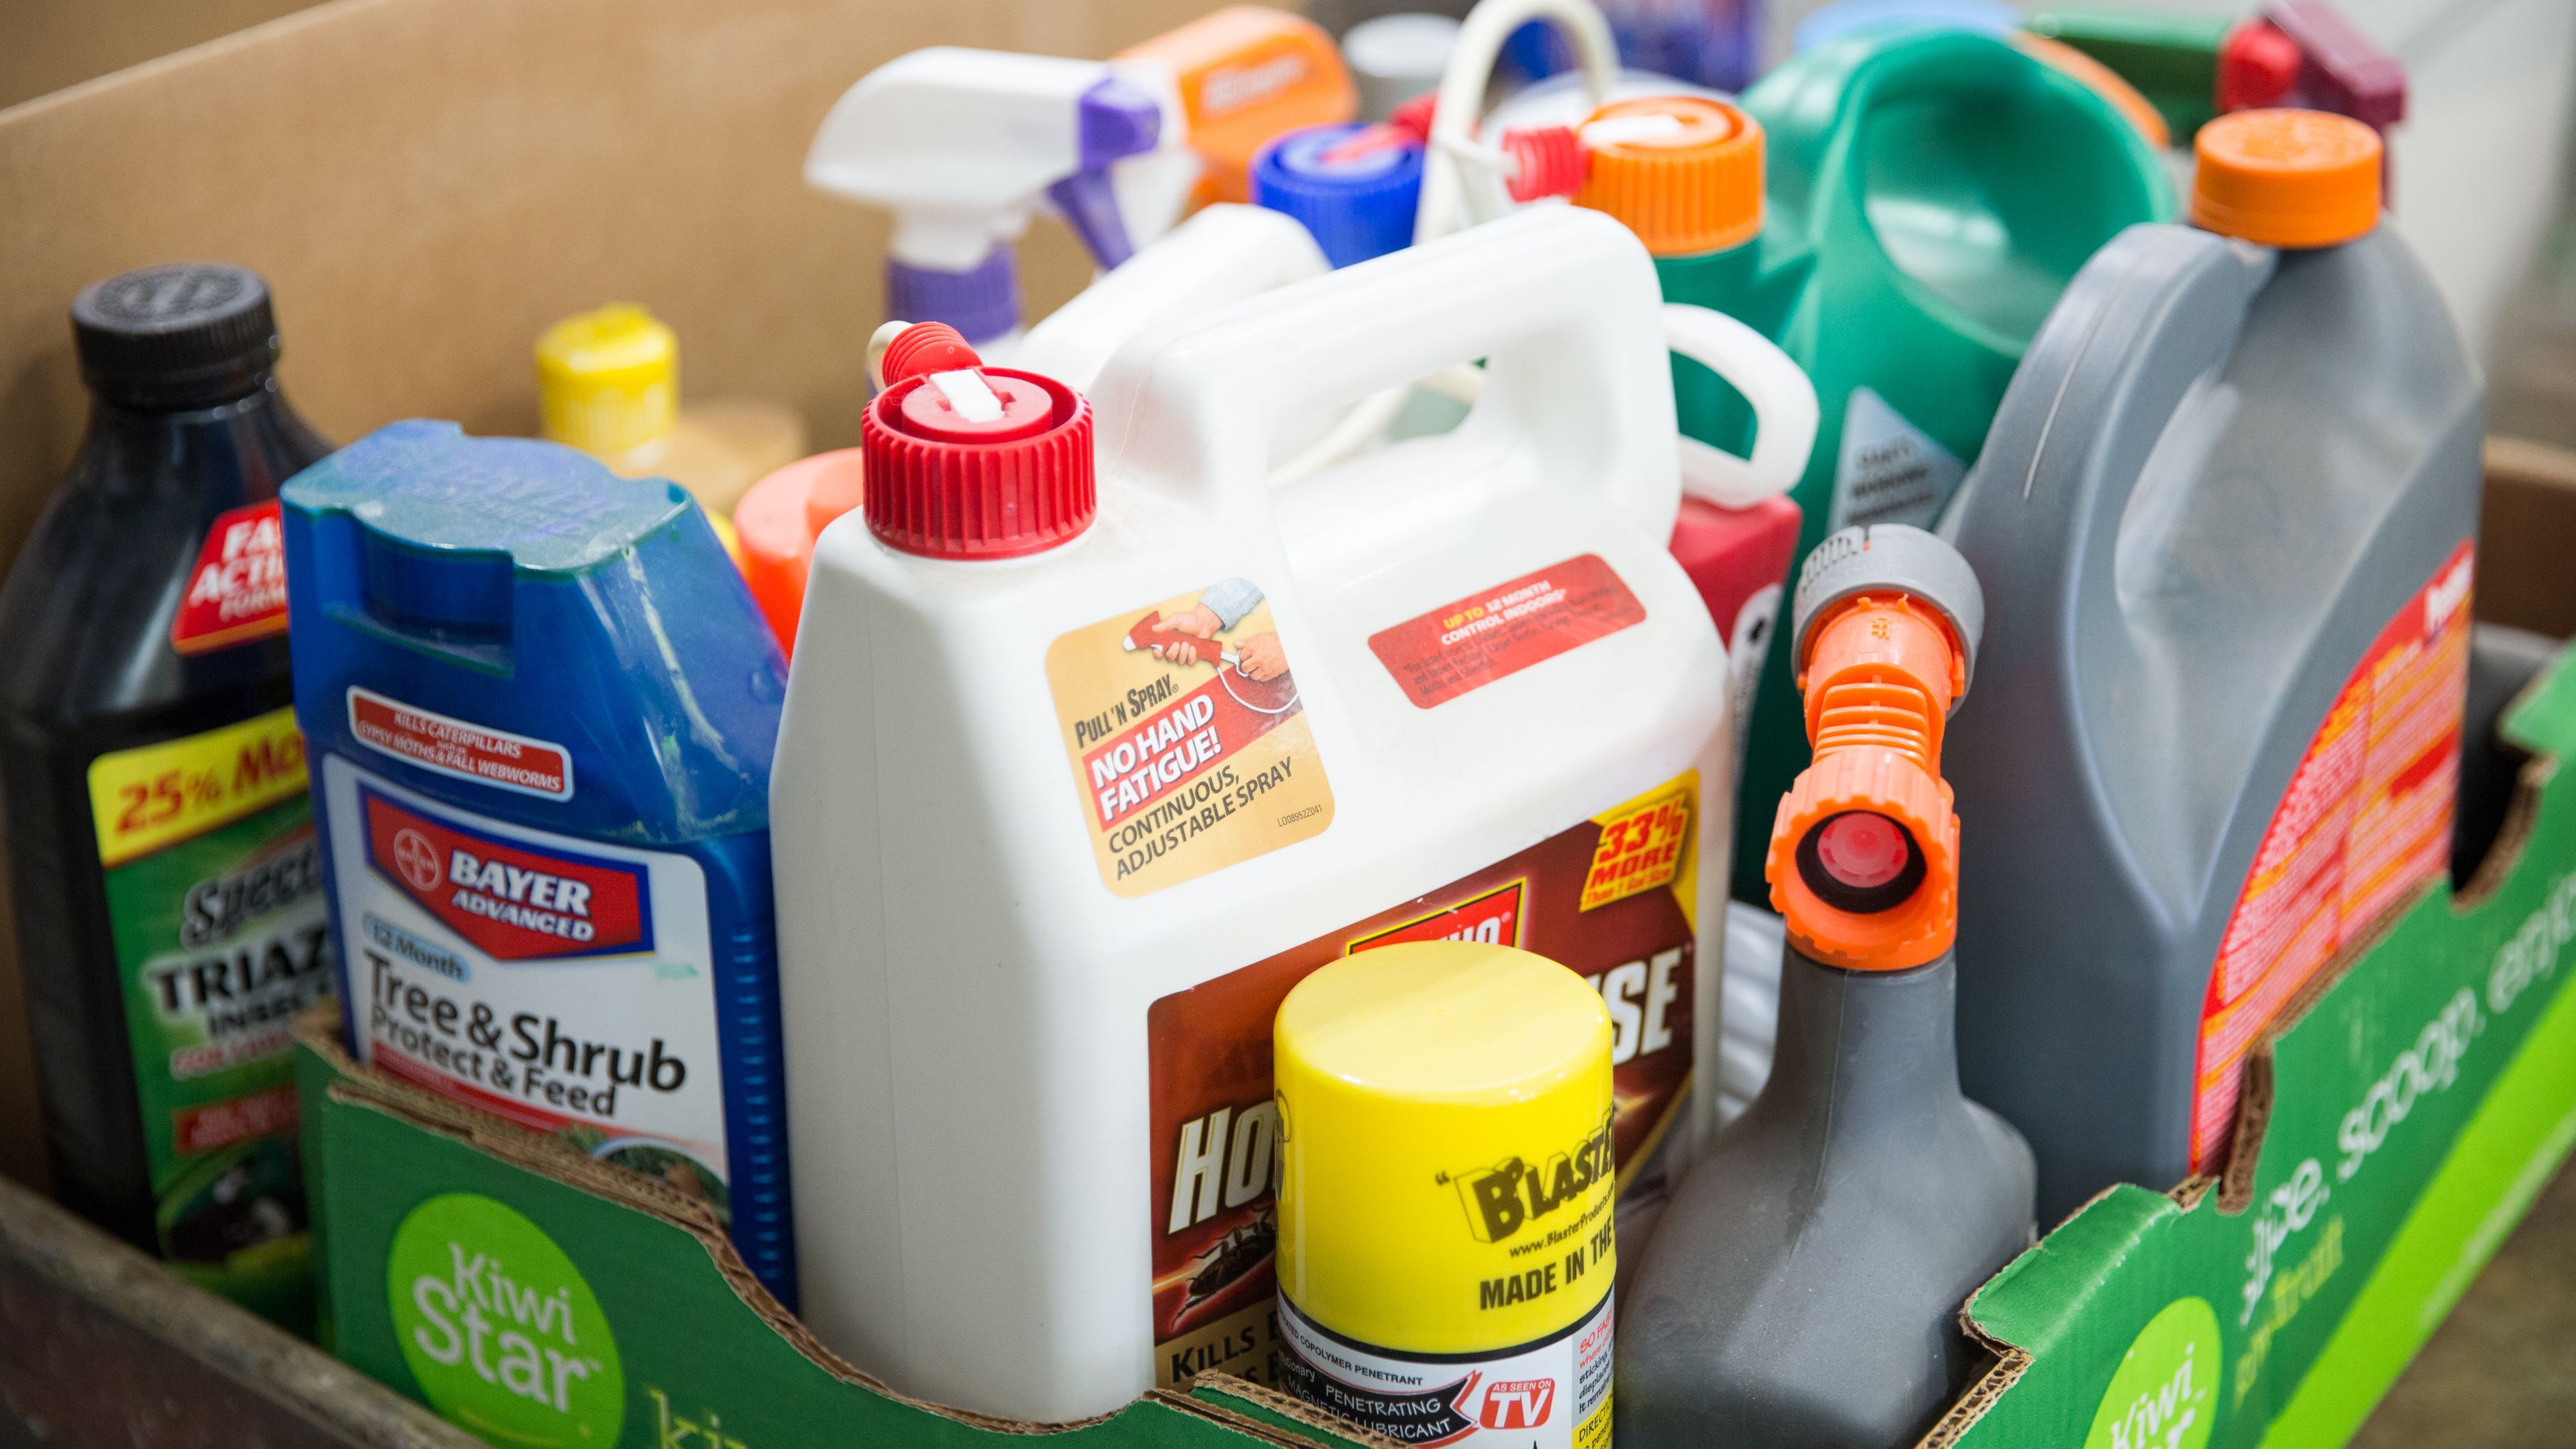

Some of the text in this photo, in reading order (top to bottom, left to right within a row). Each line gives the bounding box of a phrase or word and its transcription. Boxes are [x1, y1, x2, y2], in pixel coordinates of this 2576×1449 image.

[222, 517, 281, 562] FA
[188, 555, 284, 607] ACTI
[1440, 614, 1505, 645] CONTROL
[1443, 613, 1464, 630] UP
[1464, 606, 1485, 621] TO
[231, 731, 307, 790] MO
[358, 720, 392, 743] GYPSY
[394, 733, 436, 759] MOTHS
[447, 751, 476, 772] FALL
[477, 759, 562, 791] WEBWORMS
[394, 711, 522, 758] KILLS CATERPILLARS
[1091, 693, 1215, 788] NO HAND
[1098, 725, 1224, 823] FATIGUE!
[1108, 764, 1240, 854] CONTINUOUS,
[1116, 756, 1294, 881] ADJUSTABLE SPRAY
[1598, 799, 1684, 864] 33%
[449, 847, 592, 918] BAYER
[1589, 840, 1678, 889] MORE
[451, 889, 595, 942] ADVANCED
[150, 926, 335, 1015] TRIAZ
[373, 923, 464, 980] 12 Month
[363, 946, 459, 1037] Tree
[464, 999, 502, 1053] &
[508, 1010, 687, 1093] Shrub
[372, 1004, 482, 1080] Protect
[487, 1059, 516, 1094] &
[520, 1065, 618, 1118] Feed
[1168, 945, 1683, 1236] HO SE
[1479, 1214, 1611, 1311] MADE IN THE
[449, 1241, 577, 1346] Kiwi
[412, 1275, 590, 1414] Star
[1171, 1324, 1255, 1385] KILLS
[1300, 1335, 1352, 1371] COPOLYMER
[1355, 1365, 1423, 1387] PENETRANT
[1579, 1334, 1596, 1355] SO
[1579, 1344, 1601, 1370] where
[1325, 1384, 1441, 1417] PENETRATING
[1490, 1388, 1551, 1428] TV
[1493, 1379, 1552, 1392] AS SEEN ON
